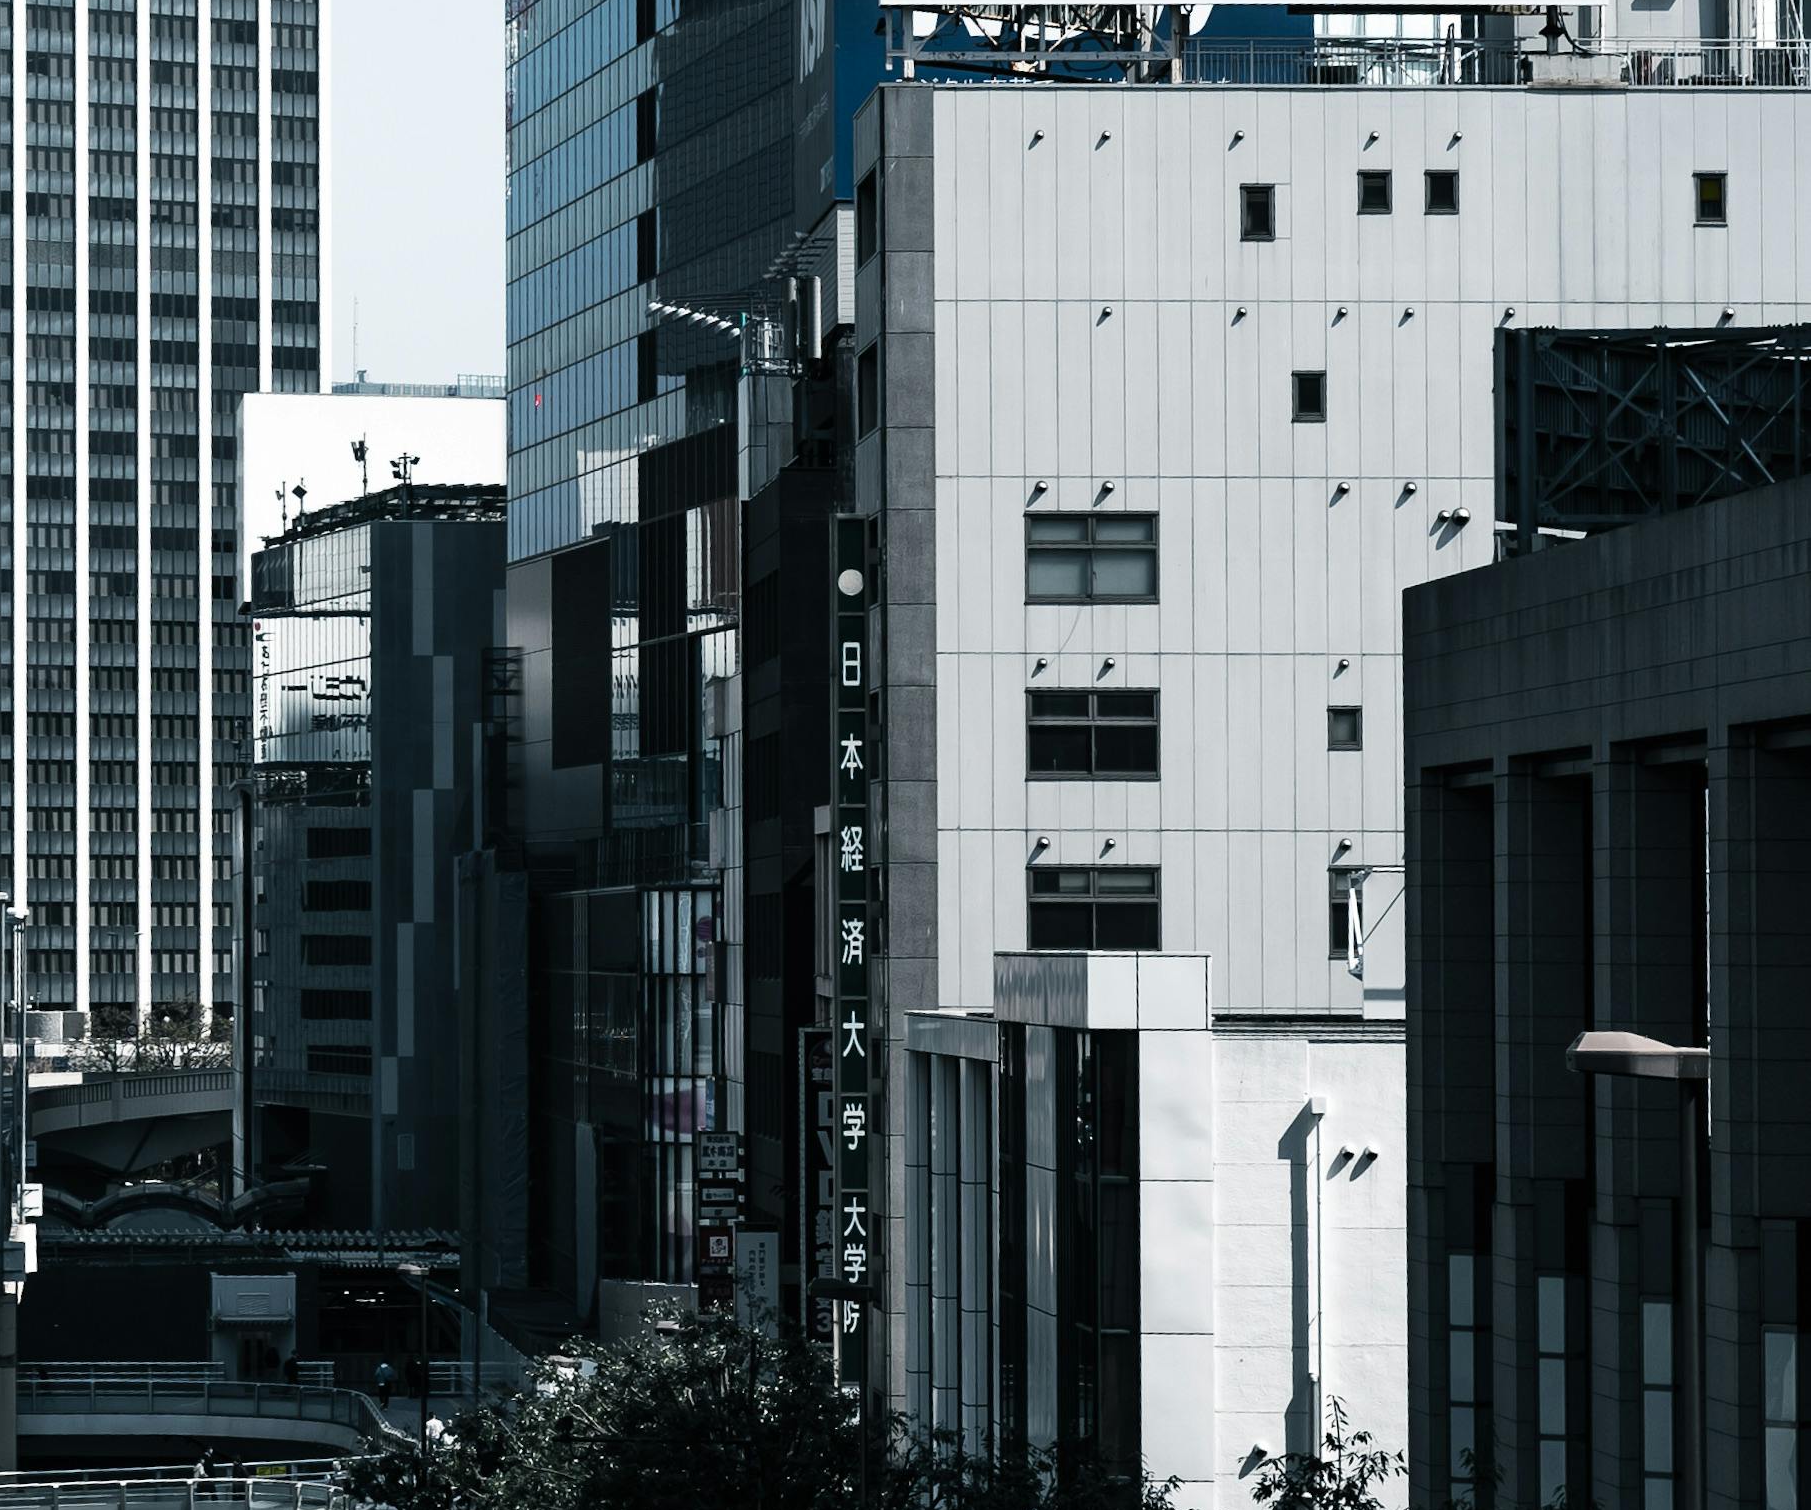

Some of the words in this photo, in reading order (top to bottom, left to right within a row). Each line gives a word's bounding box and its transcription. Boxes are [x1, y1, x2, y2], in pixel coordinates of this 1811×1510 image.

[840, 641, 866, 1151] 日本経済大学
